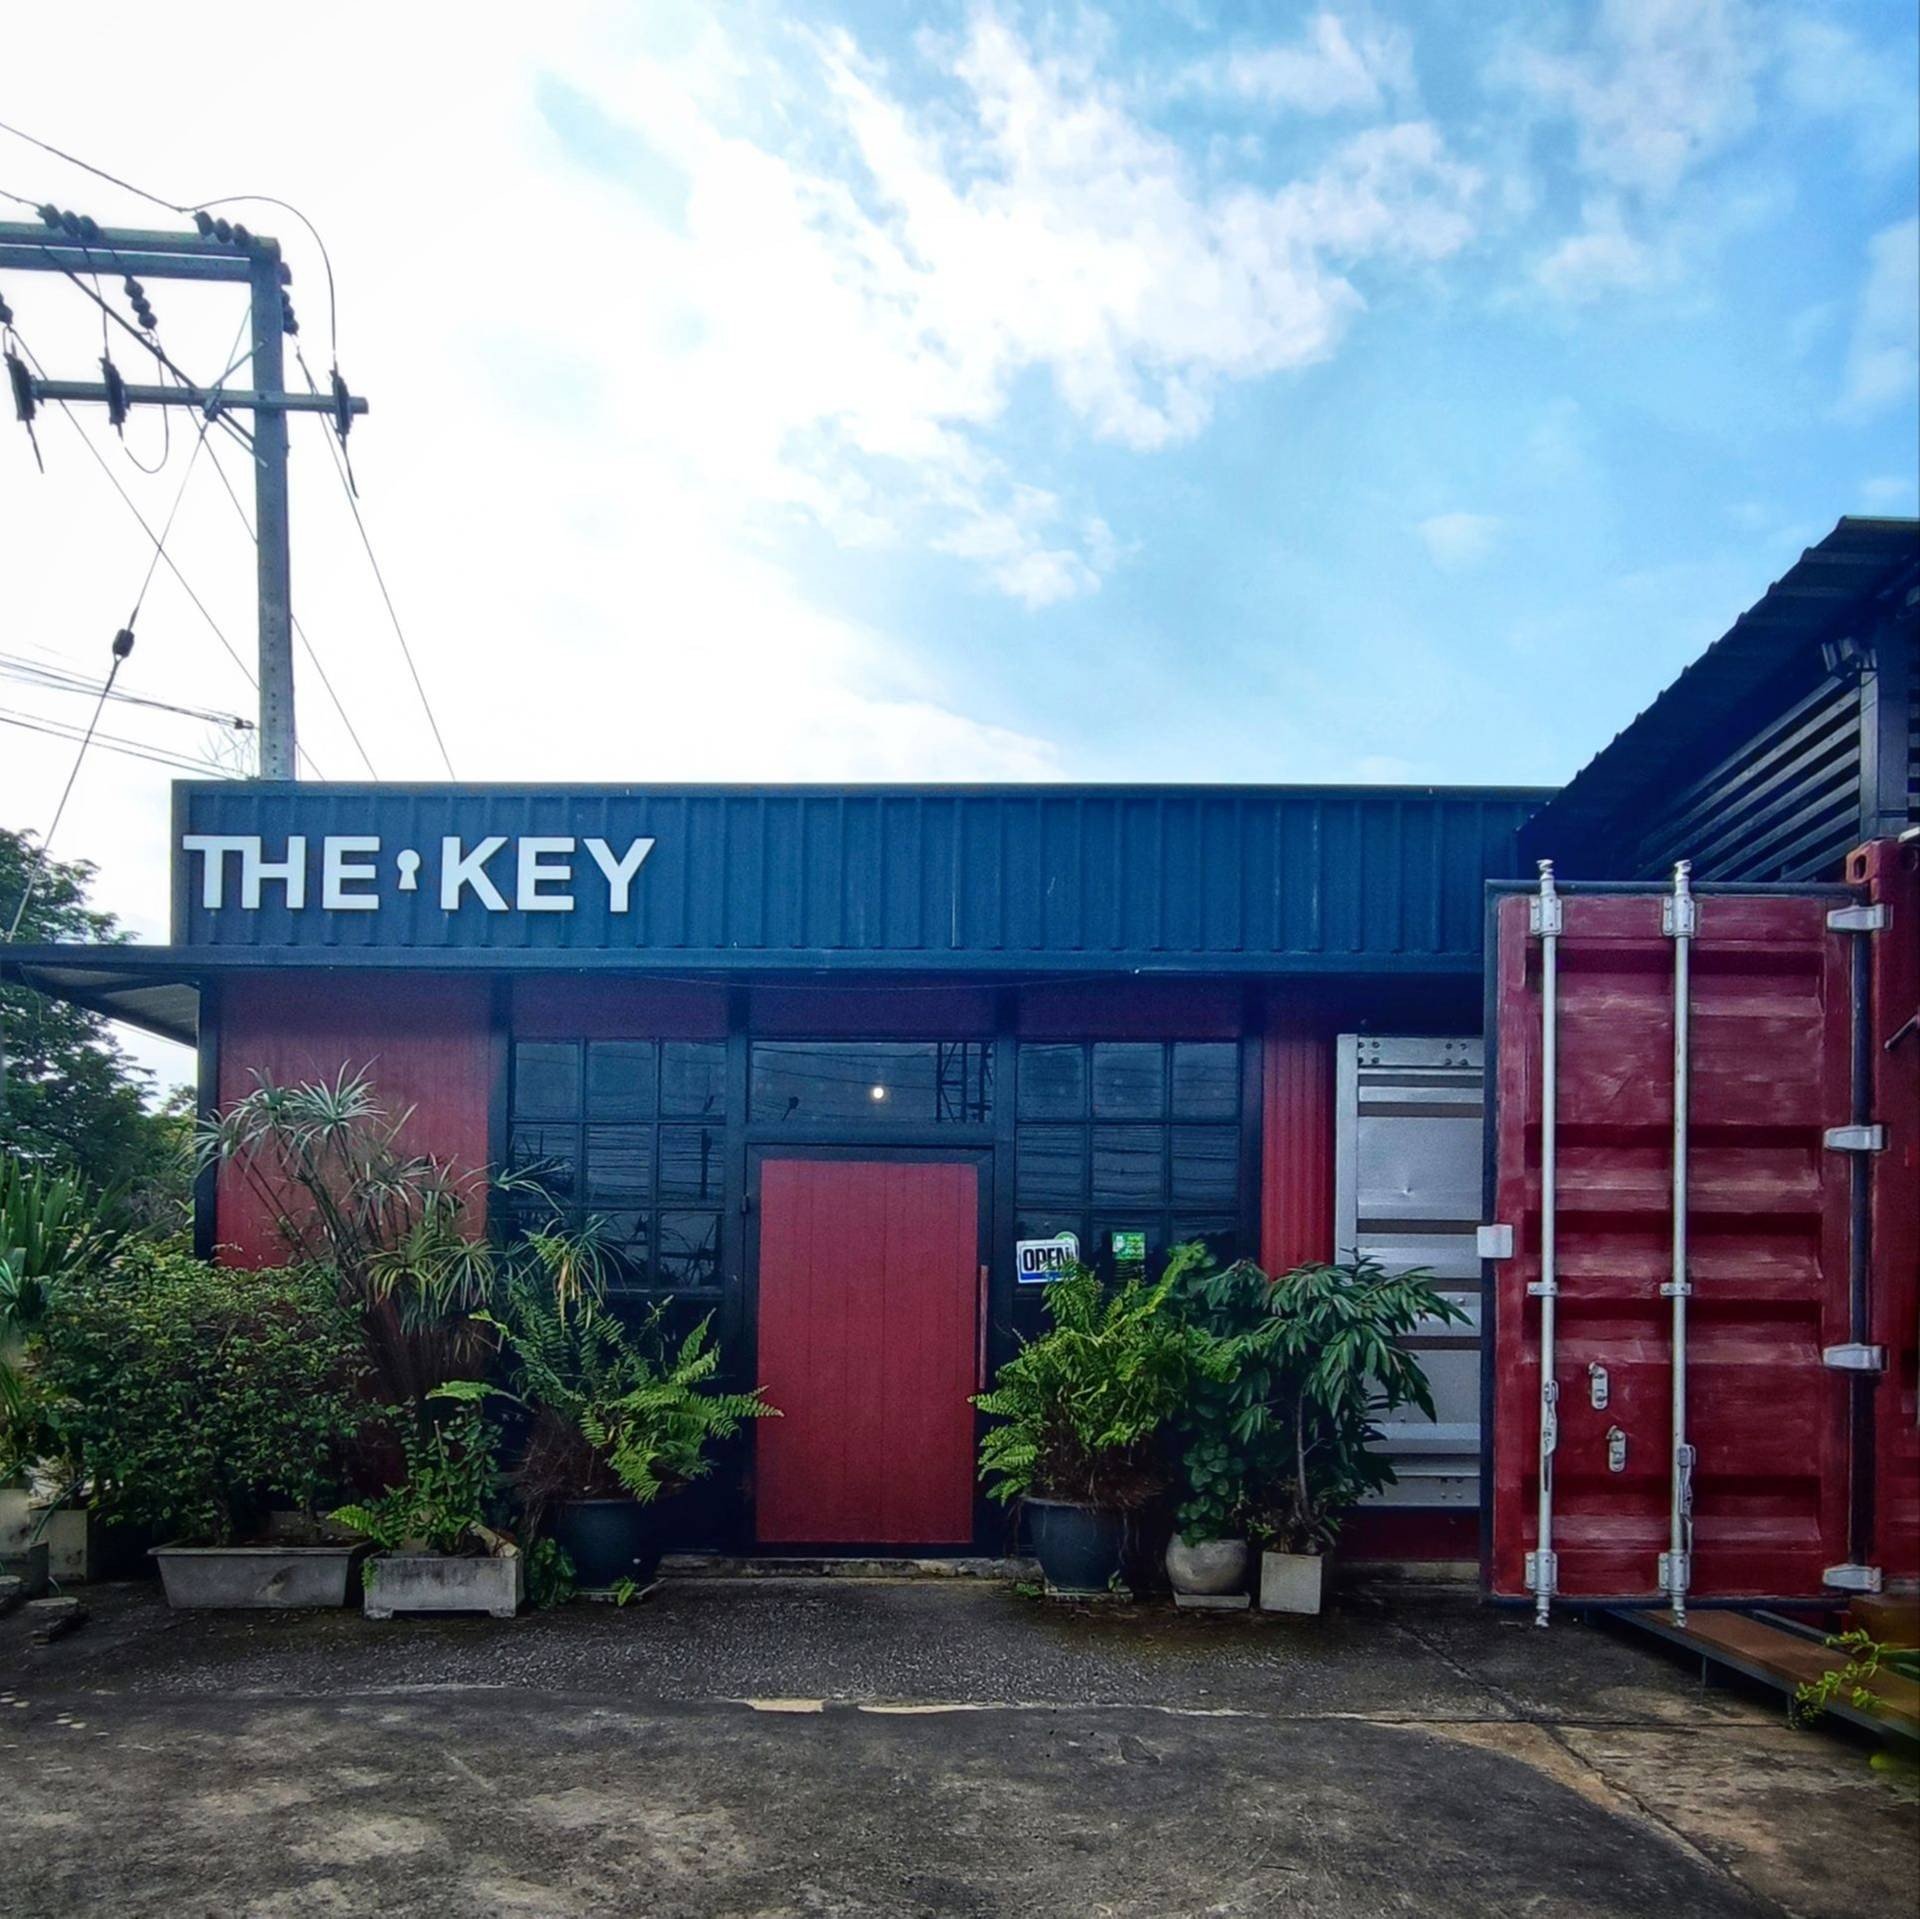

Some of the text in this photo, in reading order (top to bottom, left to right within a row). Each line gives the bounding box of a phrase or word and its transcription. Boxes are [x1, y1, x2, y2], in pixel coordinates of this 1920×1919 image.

[182, 835, 655, 912] THE KEY
[1023, 1246, 1071, 1271] OPEN
